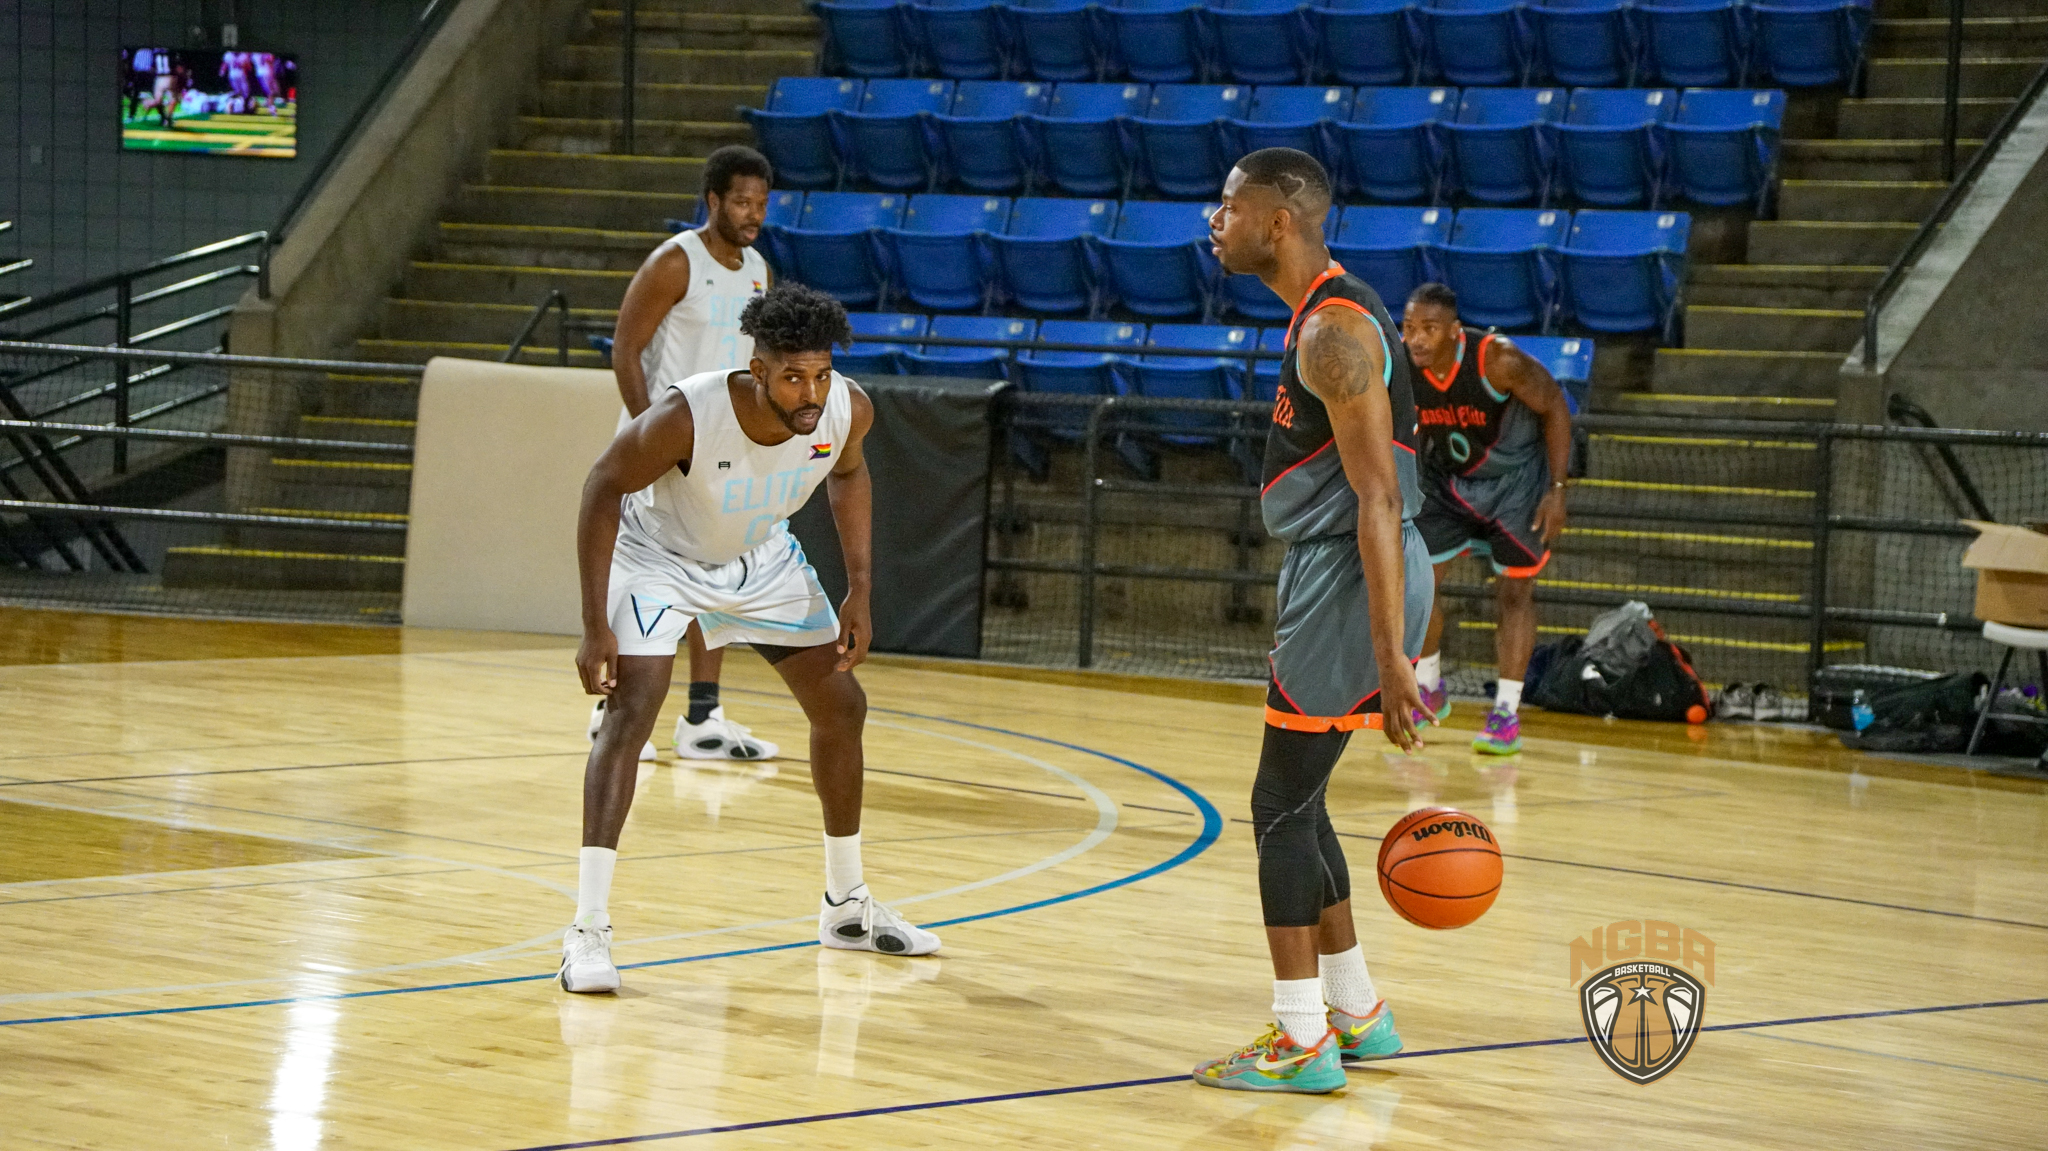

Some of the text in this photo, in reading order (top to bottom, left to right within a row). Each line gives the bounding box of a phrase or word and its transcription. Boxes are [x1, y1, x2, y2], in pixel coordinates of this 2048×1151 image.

[1449, 432, 1470, 463] 0
[721, 466, 815, 514] ELITE
[1411, 820, 1493, 845] Wilson
